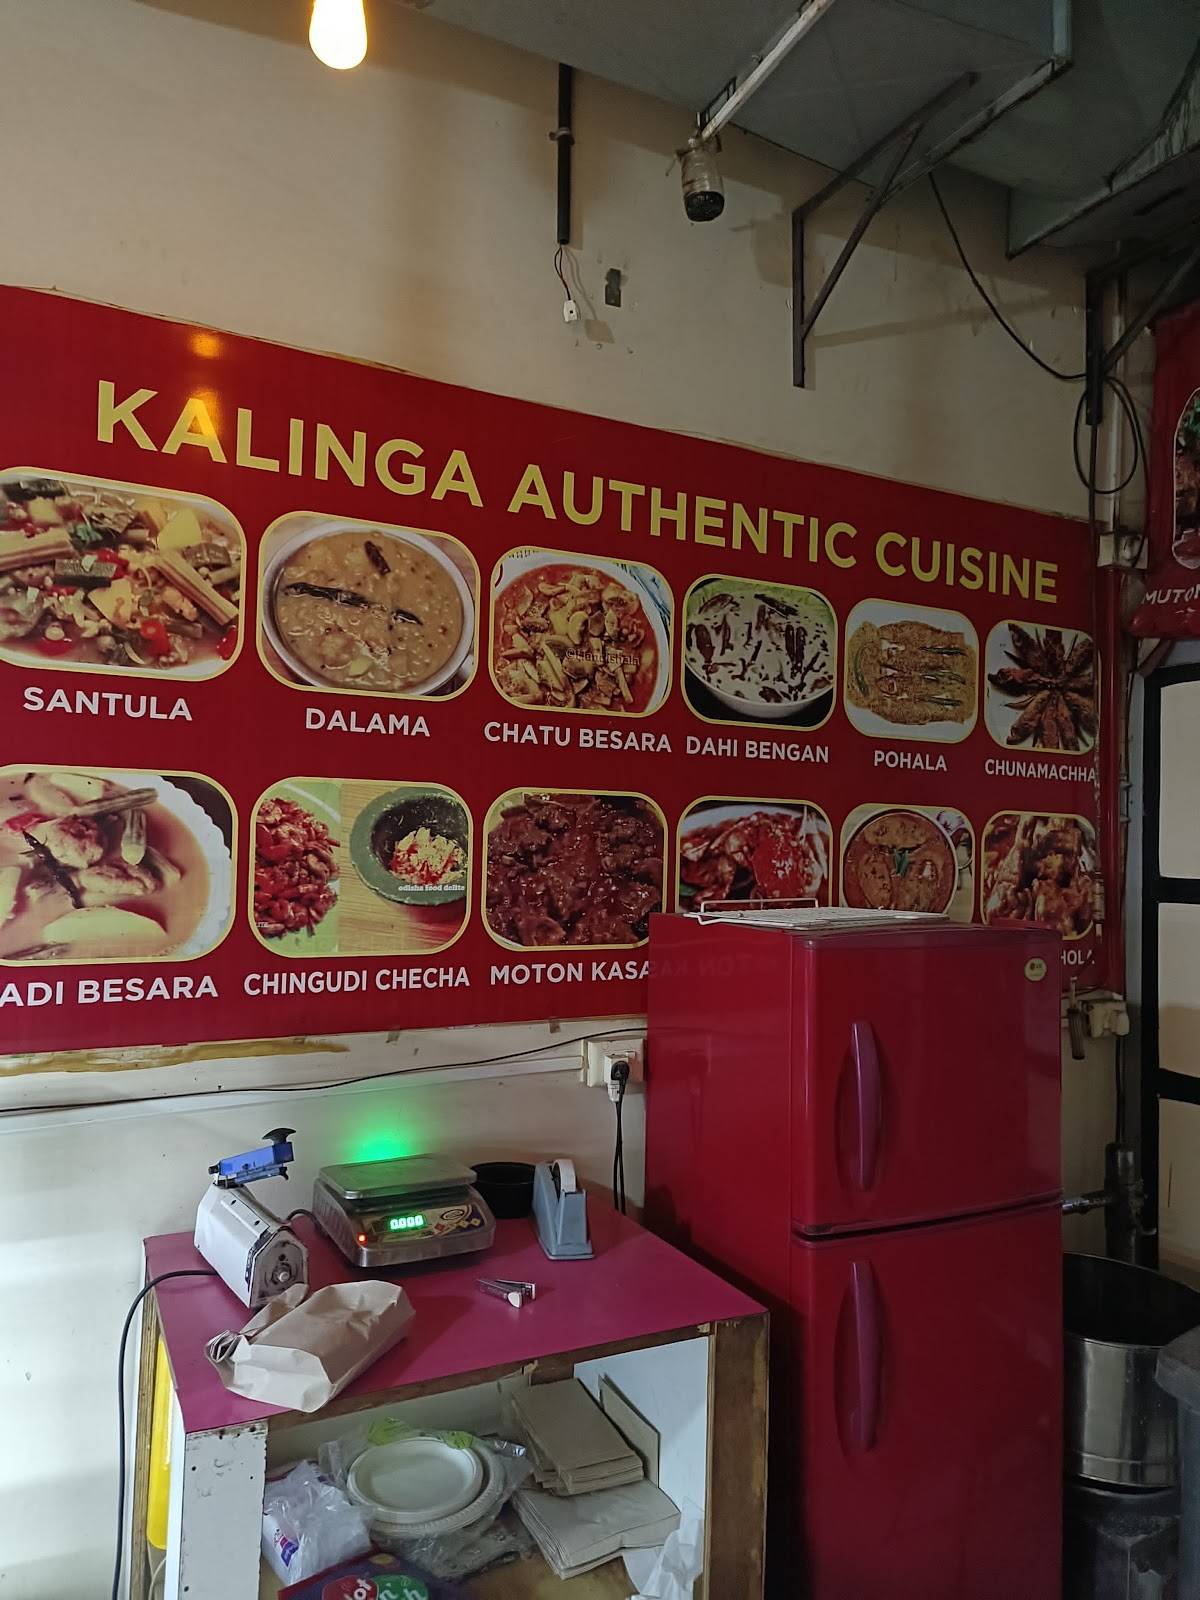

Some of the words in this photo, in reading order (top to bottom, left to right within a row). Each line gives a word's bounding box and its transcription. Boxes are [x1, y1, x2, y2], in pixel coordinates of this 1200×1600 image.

[97, 379, 483, 507] KALINGA
[508, 464, 857, 570] AUTHENTIC
[875, 531, 1059, 604] CUISINE
[22, 686, 193, 722] SANTULA
[304, 707, 431, 738] DALAMA
[484, 721, 571, 747] CHATU
[579, 728, 672, 753] BESARA
[686, 735, 738, 757] DAHI
[745, 740, 829, 763] BENGAN
[873, 750, 948, 772] POHALA
[984, 758, 1096, 782] CHUNAMACHHA
[243, 970, 368, 996] CHINGUDI
[375, 966, 471, 991] CHECHA
[490, 962, 583, 986] MOTON
[0, 981, 64, 1007] ADI
[77, 975, 219, 1004] BESARA
